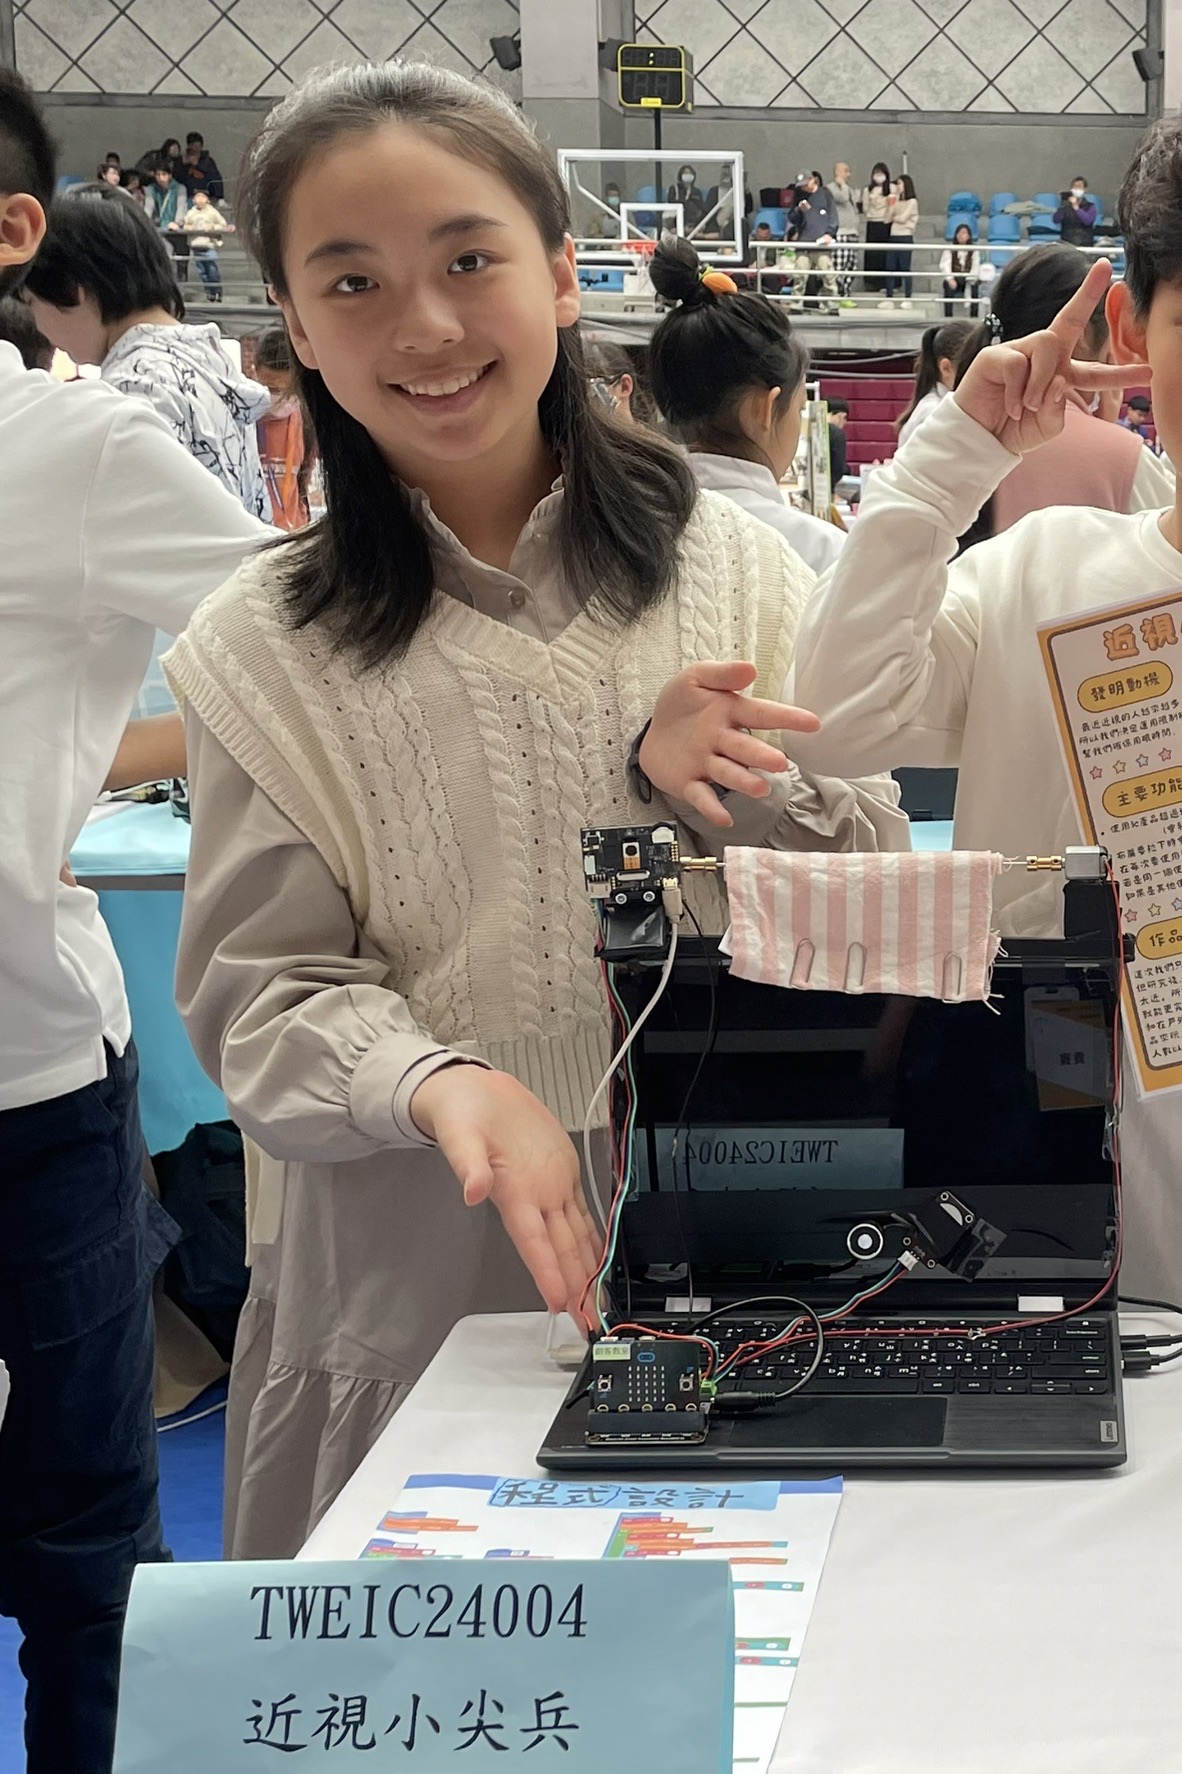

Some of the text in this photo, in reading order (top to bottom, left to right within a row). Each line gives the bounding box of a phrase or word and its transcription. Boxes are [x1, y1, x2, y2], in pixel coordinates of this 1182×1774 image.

[1090, 670, 1161, 703] 發明動機
[500, 1482, 745, 1510] 程式設計
[250, 1583, 588, 1641] TWEIC24004
[242, 1688, 580, 1753] 近視小尖兵
